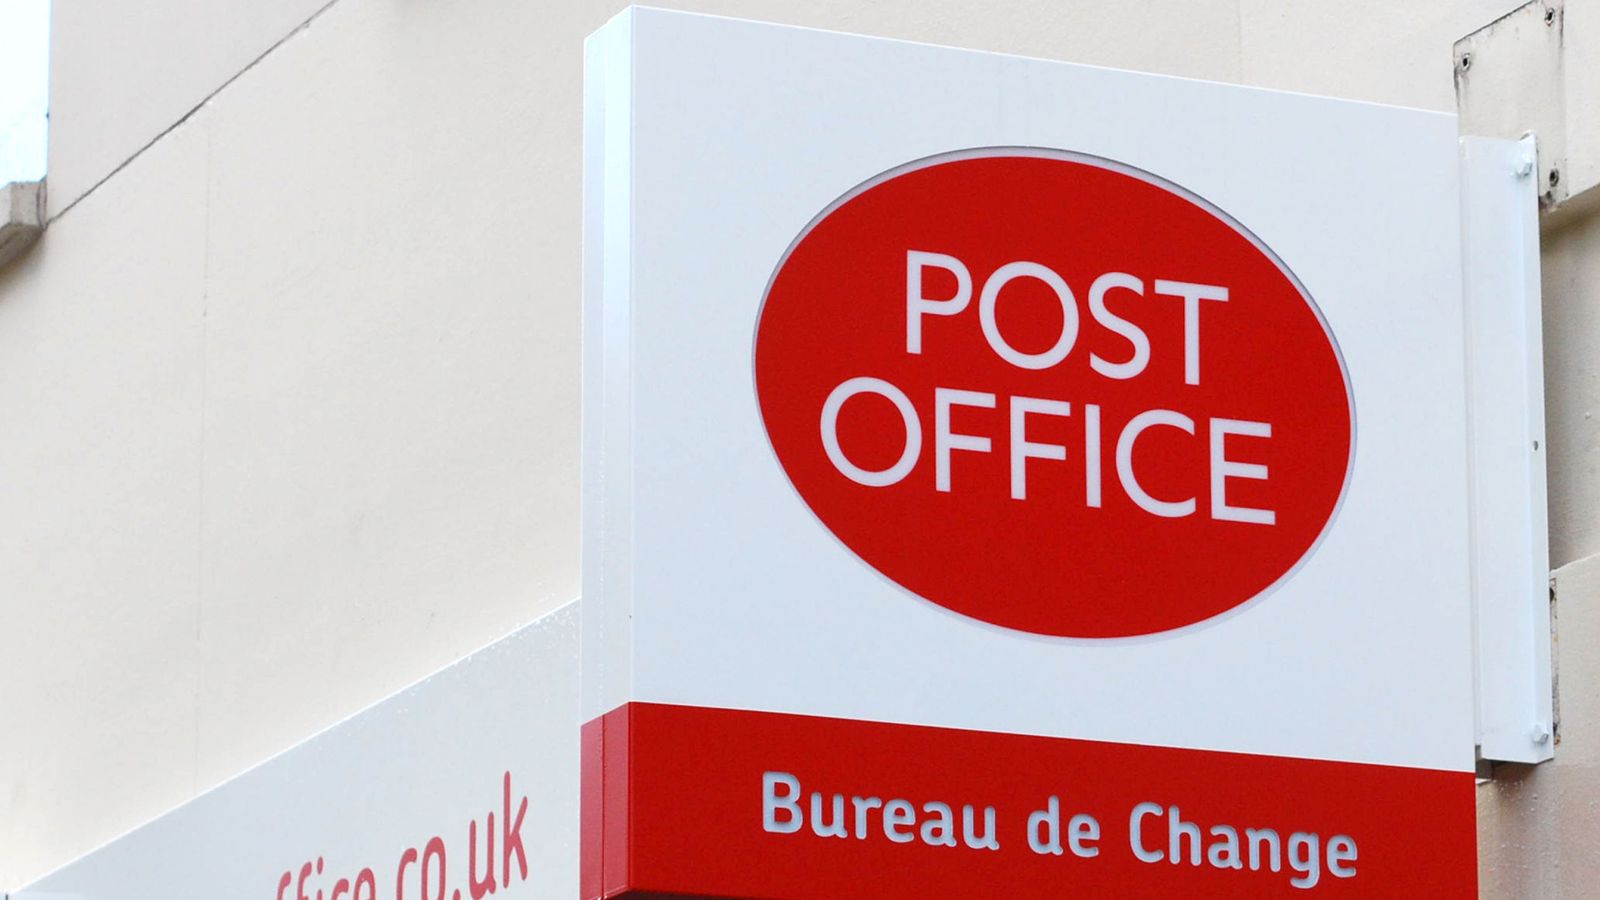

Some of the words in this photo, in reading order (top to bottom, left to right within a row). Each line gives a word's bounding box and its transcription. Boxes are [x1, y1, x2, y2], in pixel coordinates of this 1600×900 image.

[906, 249, 1230, 386] POST
[820, 376, 1277, 526] OFFICE
[762, 770, 1000, 851] Bureau
[1026, 795, 1102, 858] de
[1129, 801, 1359, 889] Change
